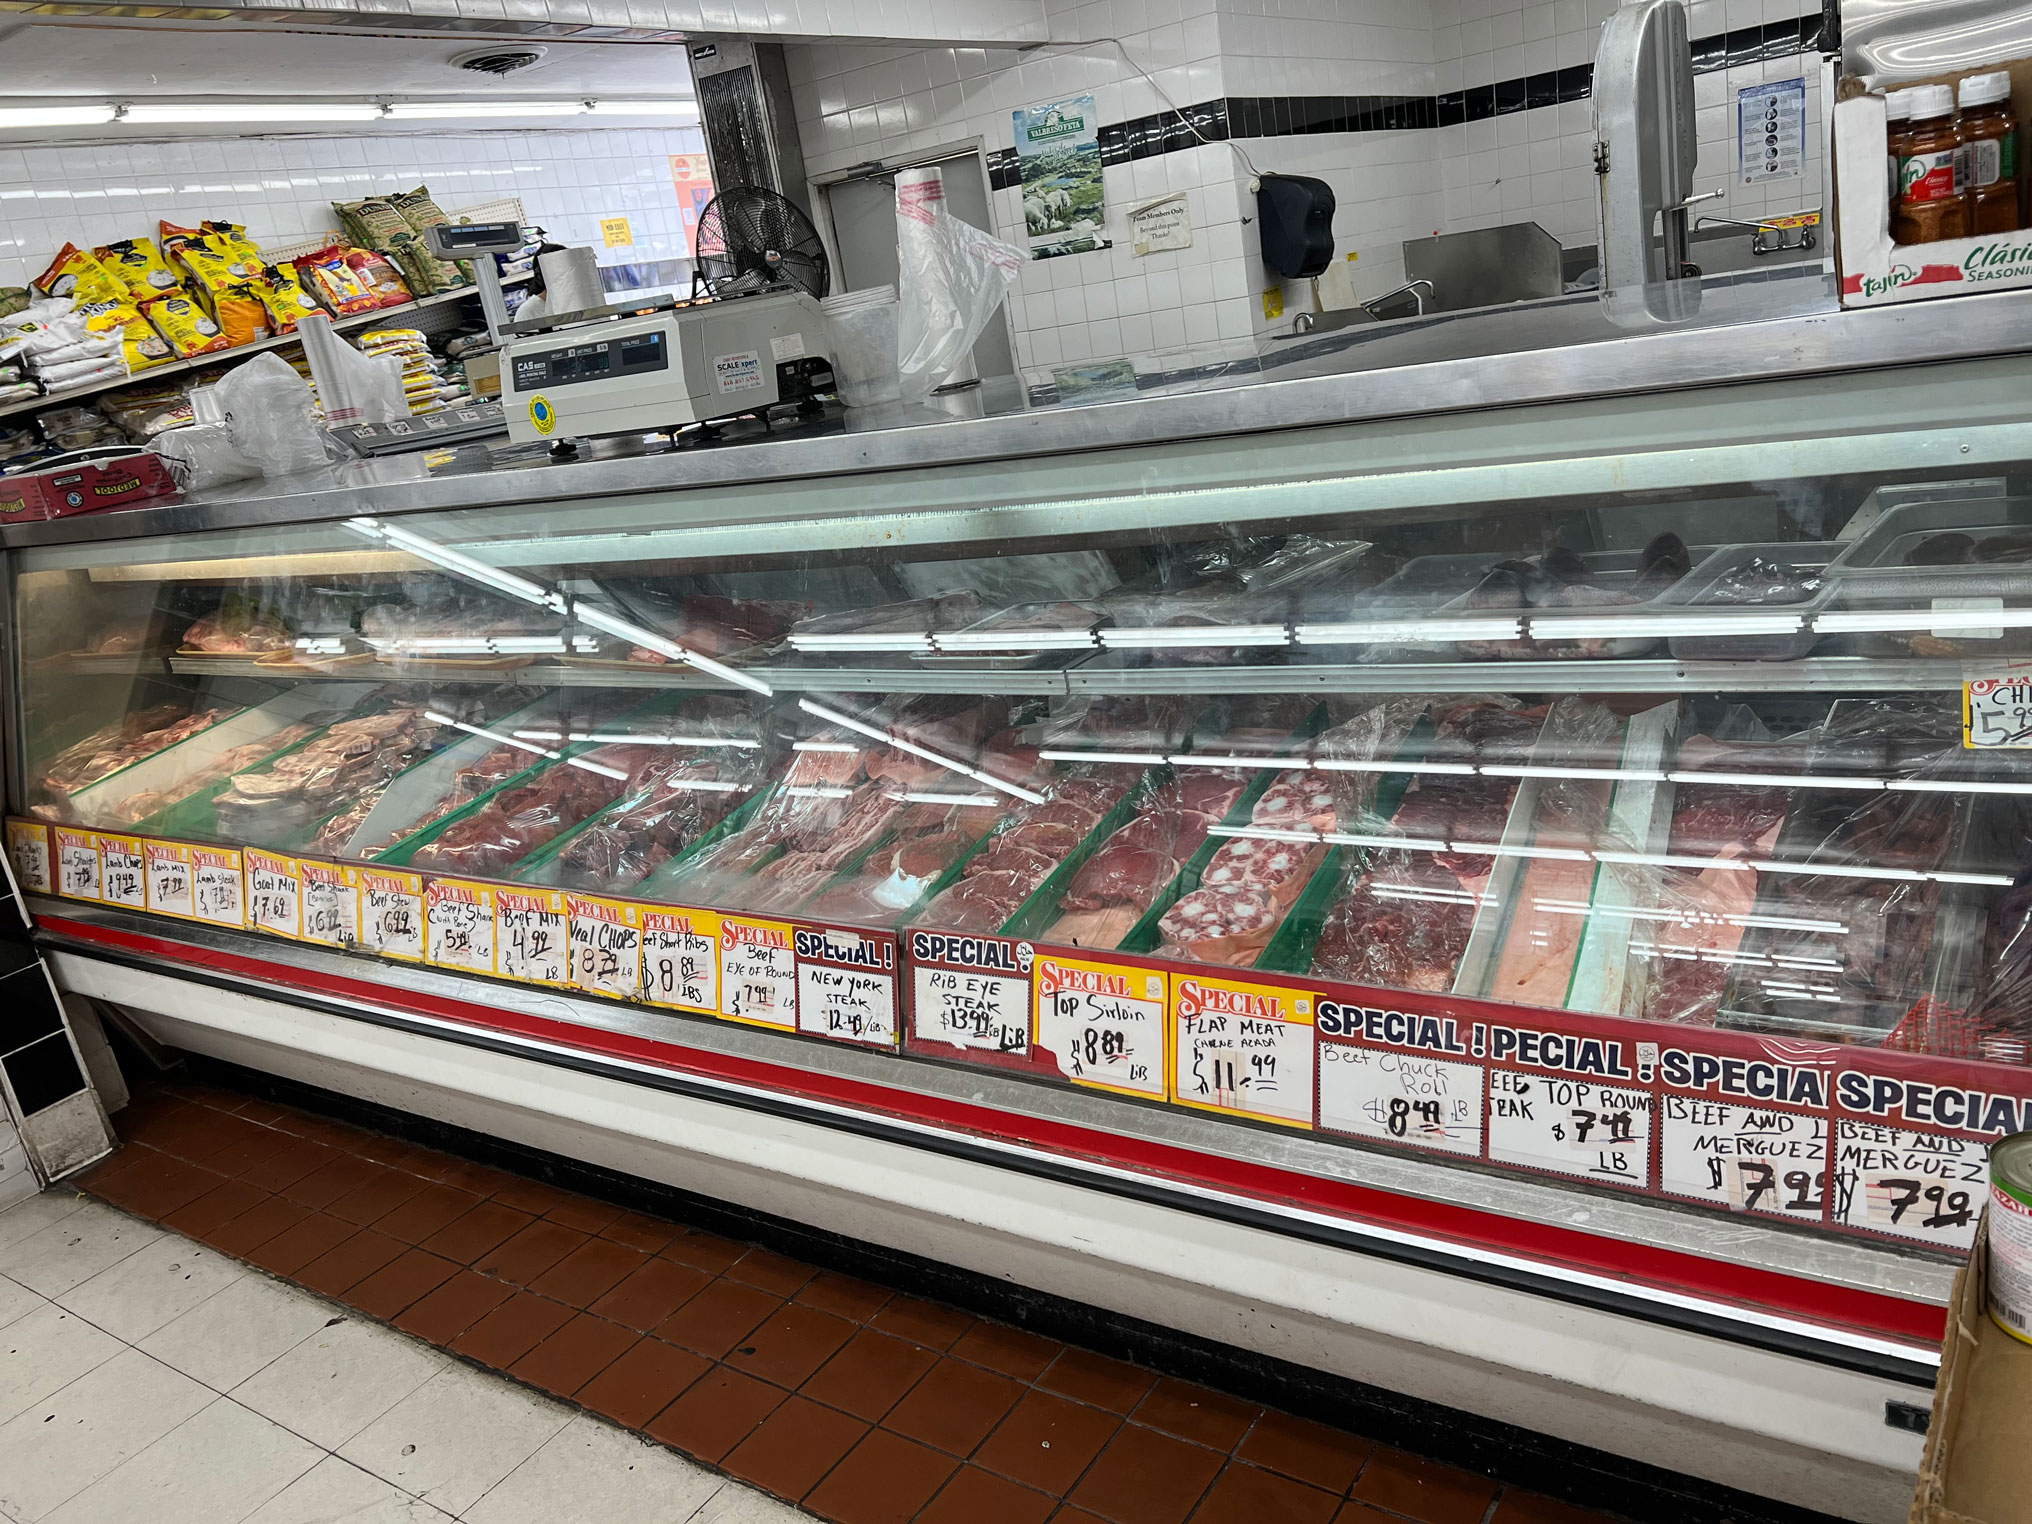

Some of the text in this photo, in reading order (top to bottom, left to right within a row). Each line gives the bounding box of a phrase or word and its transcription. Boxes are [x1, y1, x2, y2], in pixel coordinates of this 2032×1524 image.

[1967, 266, 2032, 282] SEASONI
[517, 361, 534, 372] CAS
[717, 362, 739, 371] SCALE
[741, 359, 758, 368] xpert
[100, 836, 131, 857] SPECIAL
[146, 843, 179, 864] SPECIAL
[193, 848, 228, 871] SPECIAL
[247, 850, 286, 873] SPECIAL
[301, 863, 344, 888] SPECIAL
[362, 871, 406, 894] SPECIAL
[427, 880, 476, 907] SPECIAL
[495, 889, 549, 916] SPECIAL
[567, 893, 622, 924] SPECIAL
[643, 912, 694, 936] PECIAL
[720, 919, 789, 951] SPECIAL
[913, 932, 1030, 973] SPECIAL
[546, 966, 558, 980] LB
[748, 966, 761, 977] OF
[1039, 961, 1131, 998] SPECIAL
[811, 971, 883, 998] NEW YORK
[966, 979, 1002, 1000] EYE
[826, 993, 871, 1011] STEAK
[942, 994, 1002, 1015] STEAK
[1086, 994, 1145, 1022] Sirloin
[1177, 980, 1286, 1020] SPECIAL
[1185, 1013, 1285, 1037] FLAP MEAT
[1324, 1044, 1448, 1080] Beef Chuck
[1490, 1025, 1655, 1083] PECIAL
[1400, 1073, 1447, 1096] Roll
[1662, 1049, 1830, 1108] SPECIA
[1539, 1080, 1590, 1107] TOP
[1451, 1099, 1468, 1122] LB
[1489, 1096, 1534, 1120] TEAK
[1667, 1097, 1731, 1125] BEEF
[1741, 1113, 1793, 1132] AND
[1694, 1135, 1825, 1161] MERGUEZ
[1840, 1122, 1965, 1152] BEEF AND
[1599, 1151, 1628, 1171] LB
[1840, 1145, 1985, 1184] MERGUEZ
